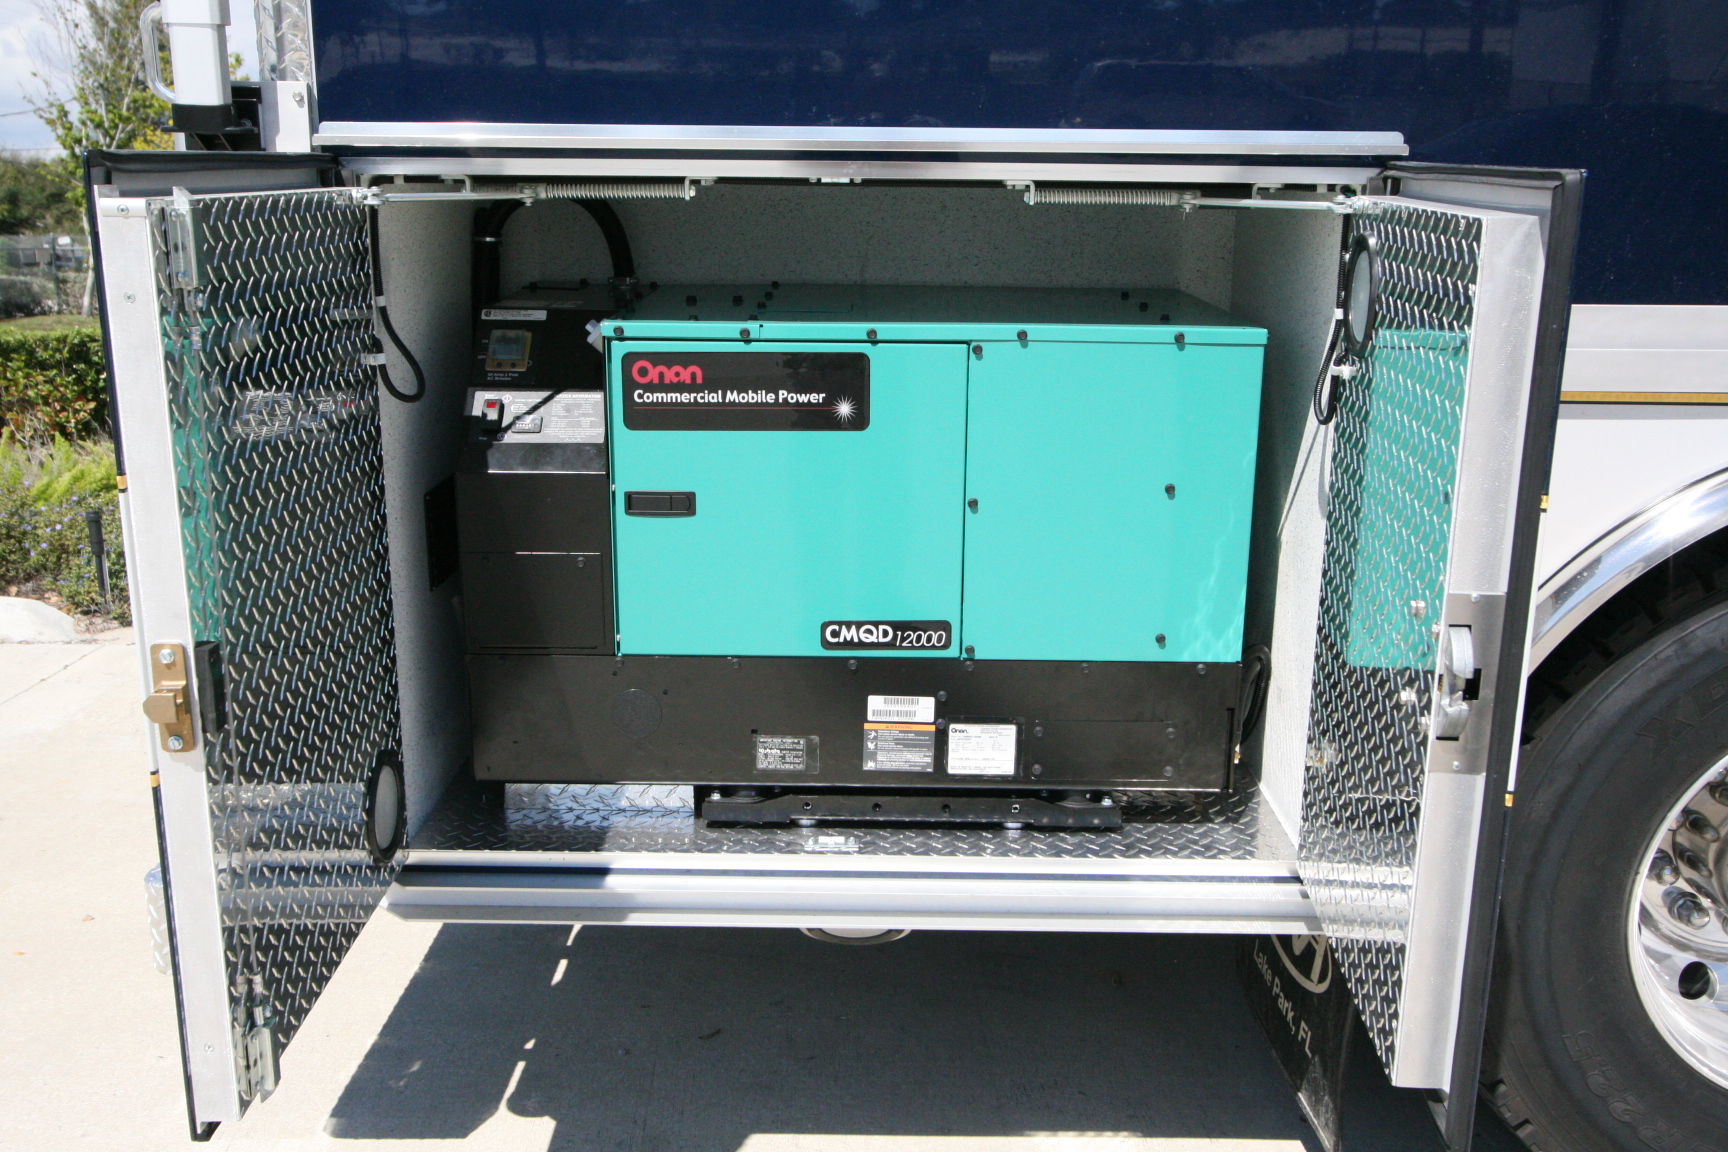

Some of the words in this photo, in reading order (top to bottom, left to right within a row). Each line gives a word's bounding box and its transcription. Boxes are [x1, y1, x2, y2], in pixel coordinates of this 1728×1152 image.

[631, 360, 703, 384] Onan
[633, 390, 722, 404] Commercial
[725, 390, 776, 404] Mobile
[778, 390, 826, 404] Power
[825, 624, 893, 643] CMQD
[895, 631, 946, 647] 12000
[1253, 938, 1272, 986] Lake
[1272, 976, 1296, 1034] Park,
[1298, 1020, 1312, 1059] FL
